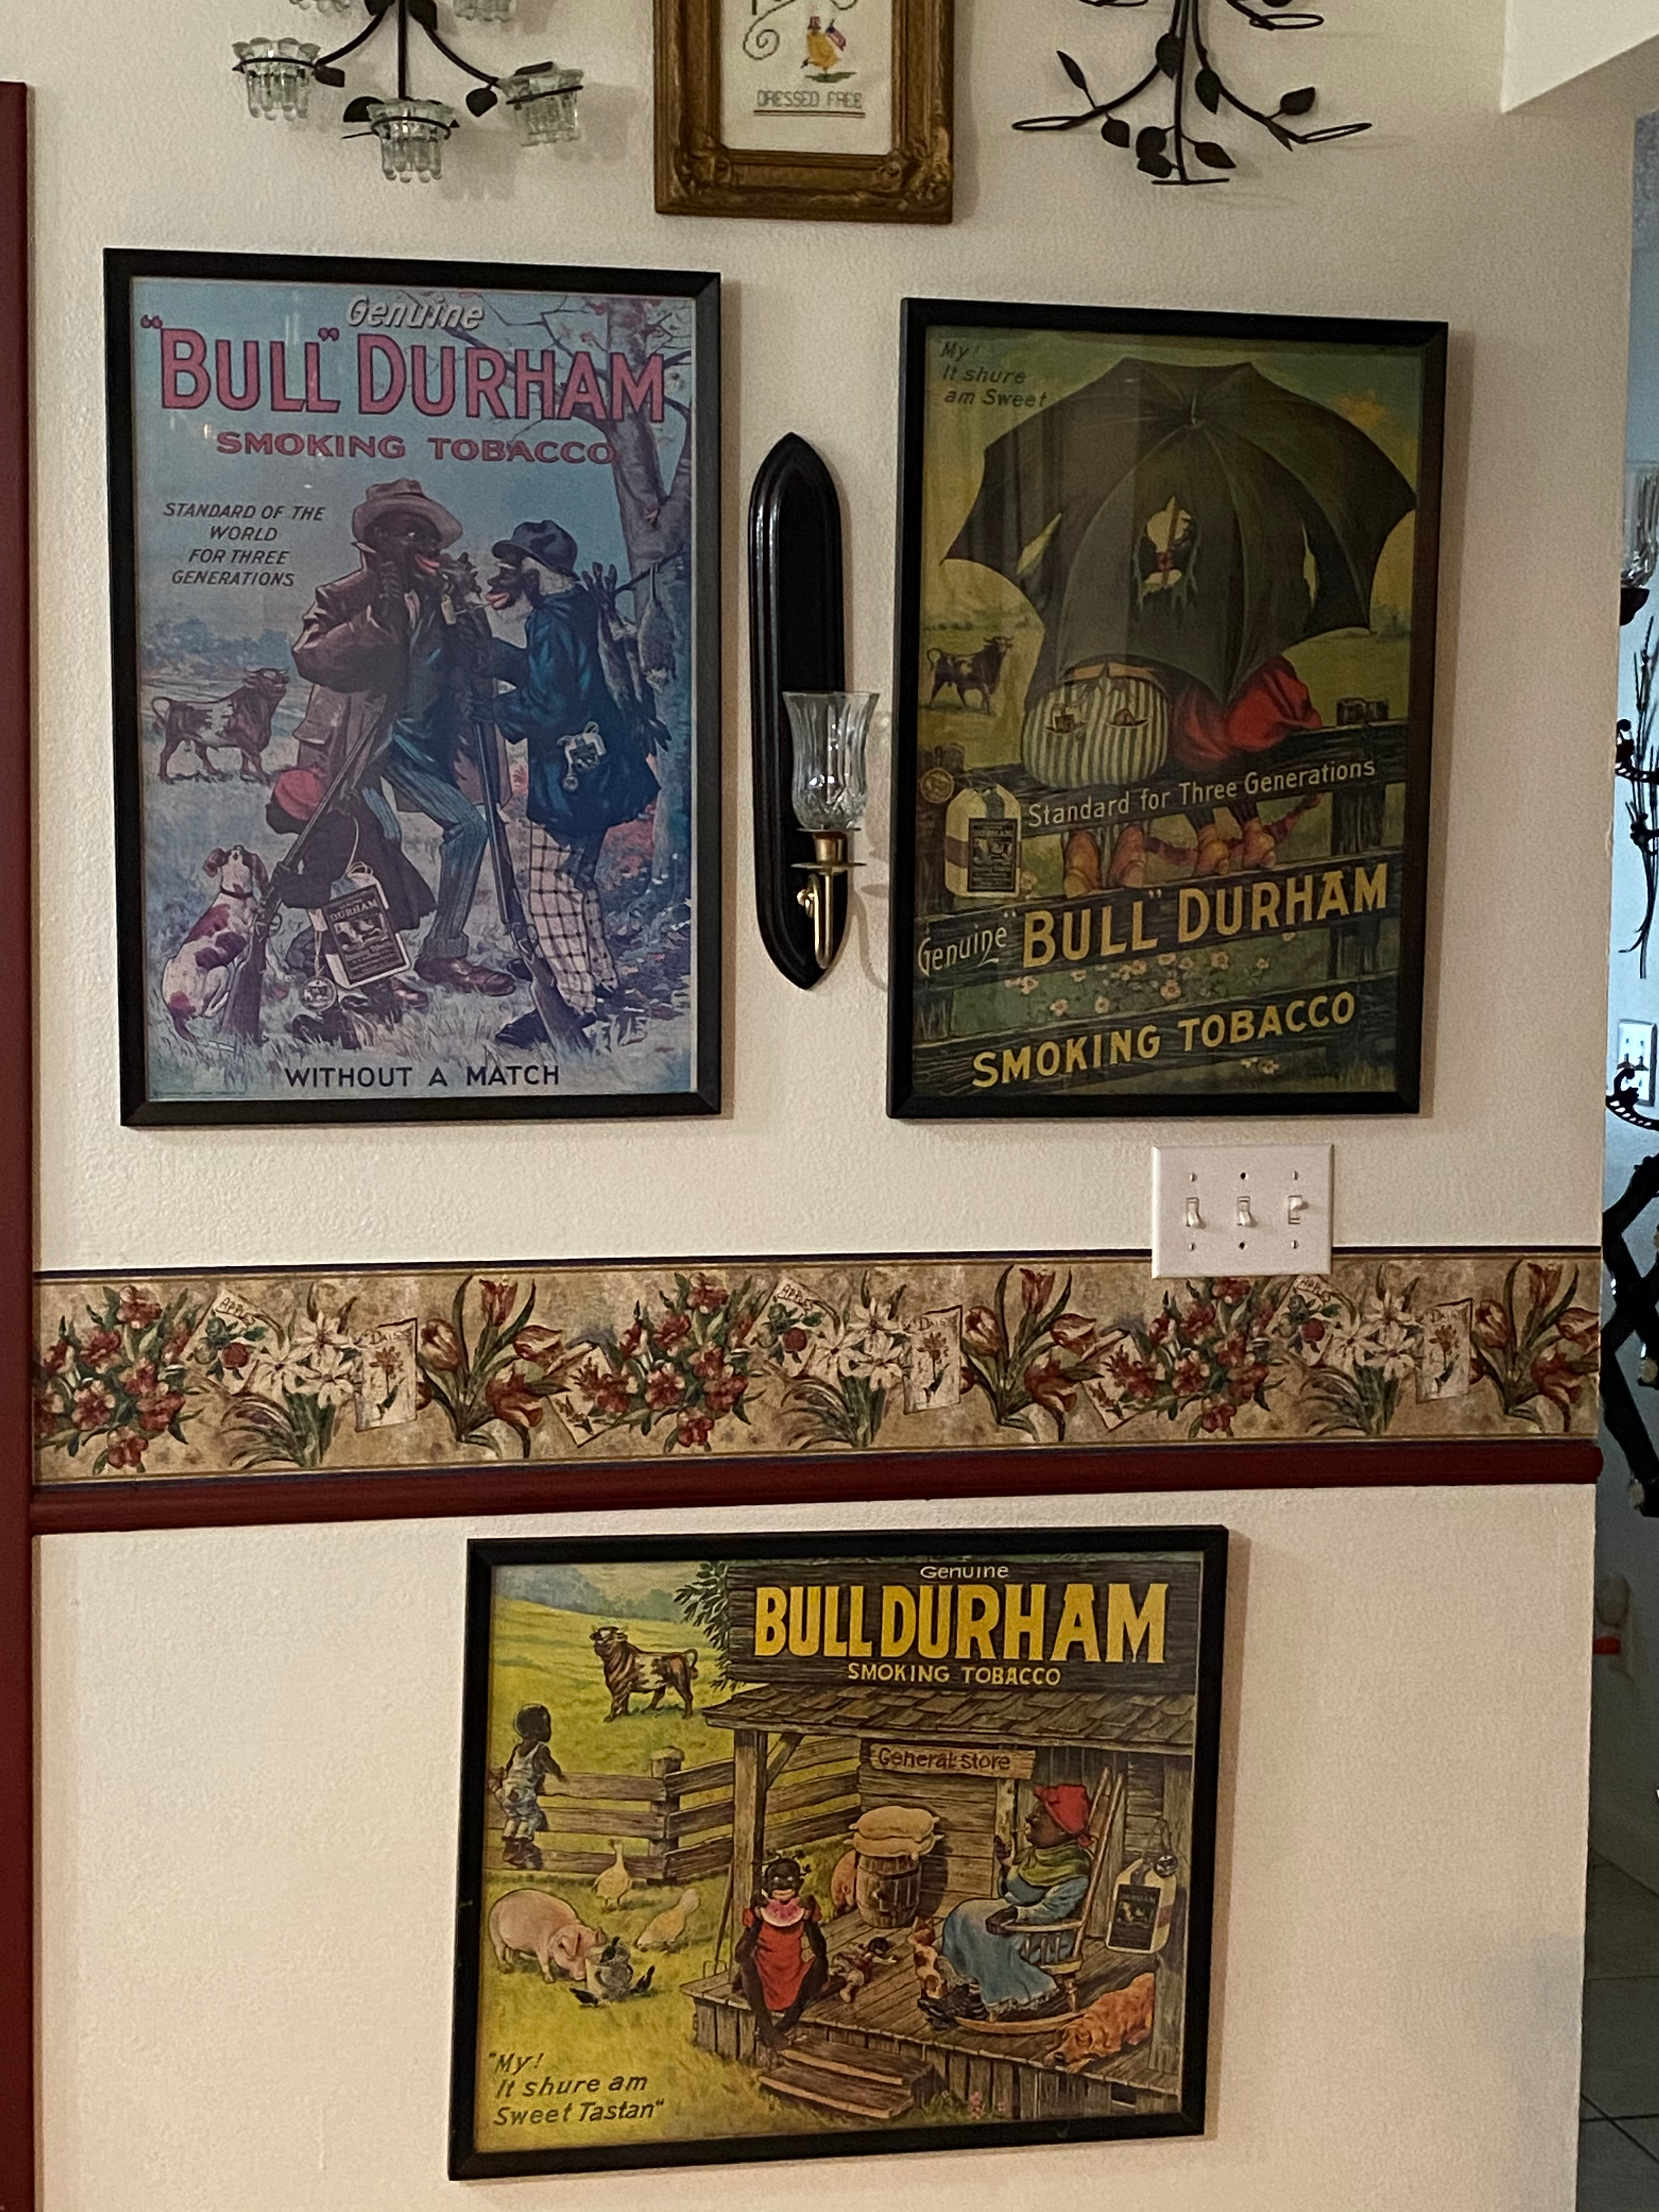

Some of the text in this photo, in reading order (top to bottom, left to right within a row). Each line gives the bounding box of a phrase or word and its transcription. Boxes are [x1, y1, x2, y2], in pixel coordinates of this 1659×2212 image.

[347, 294, 486, 330] Genuine
[357, 333, 665, 423] DURHAM
[964, 365, 1026, 384] shure
[944, 388, 1047, 408] am Sweet
[217, 431, 618, 465] SMOKING TOBACCO
[163, 502, 326, 521] STANDARD OF THE
[210, 525, 278, 541] WORLD
[188, 549, 290, 565] FOR THREE
[171, 569, 295, 586] GENERATIONS
[1028, 759, 1376, 828] Standard for Three Generations
[918, 923, 1007, 978] Genuine
[1177, 862, 1387, 944] DURHAM
[972, 991, 1356, 1088] SMOKING TOBACCO
[285, 1065, 559, 1087] WITHOUT A MATCH
[920, 1565, 1009, 1579] Genuine
[754, 1583, 1169, 1664] BULL DURHAM
[848, 1663, 1062, 1686] SMOKING TOBACCO
[495, 2075, 648, 2099] It shure am
[494, 2102, 573, 2126] Sweet
